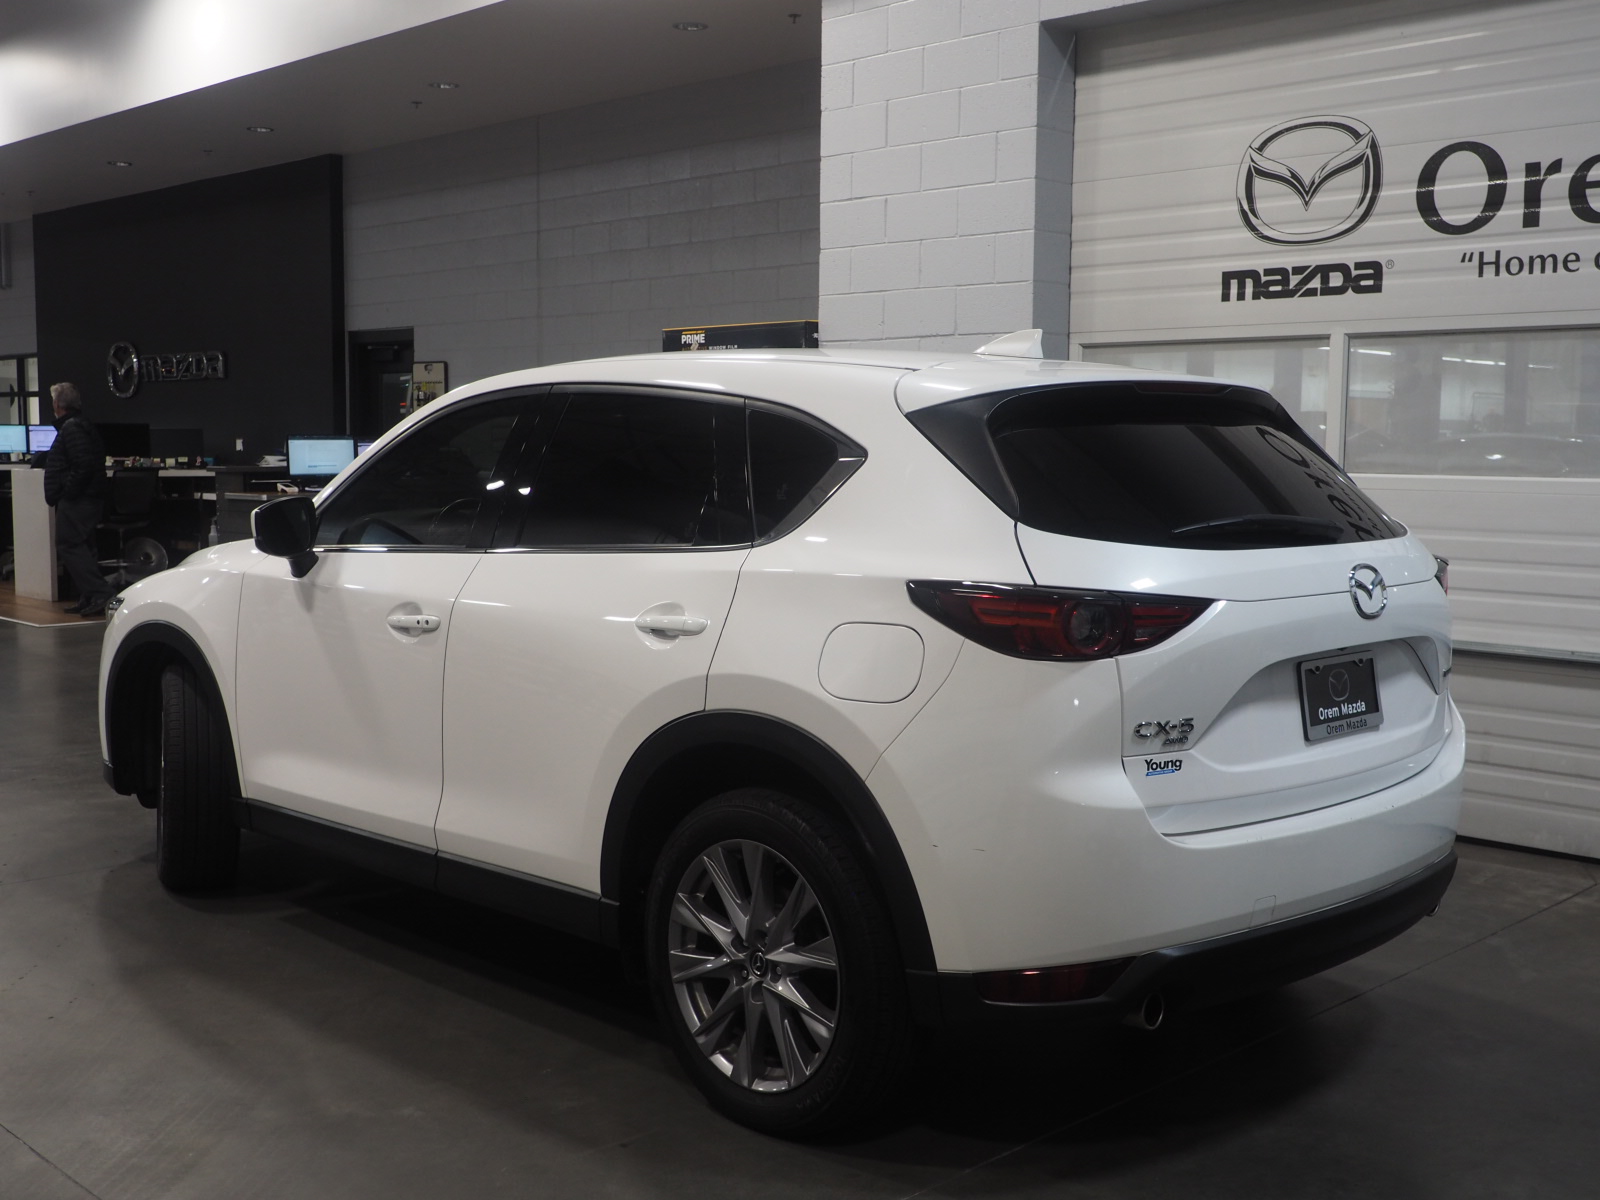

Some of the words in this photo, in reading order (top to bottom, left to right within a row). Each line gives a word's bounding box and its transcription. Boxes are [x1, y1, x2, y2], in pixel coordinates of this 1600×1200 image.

[681, 334, 706, 345] PRIME
[1318, 707, 1340, 720] Orem
[1341, 699, 1366, 716] Mazda
[1133, 717, 1194, 738] CX-5
[1326, 723, 1345, 735] Orem
[1345, 717, 1368, 731] Mazda
[1144, 758, 1183, 771] Young
